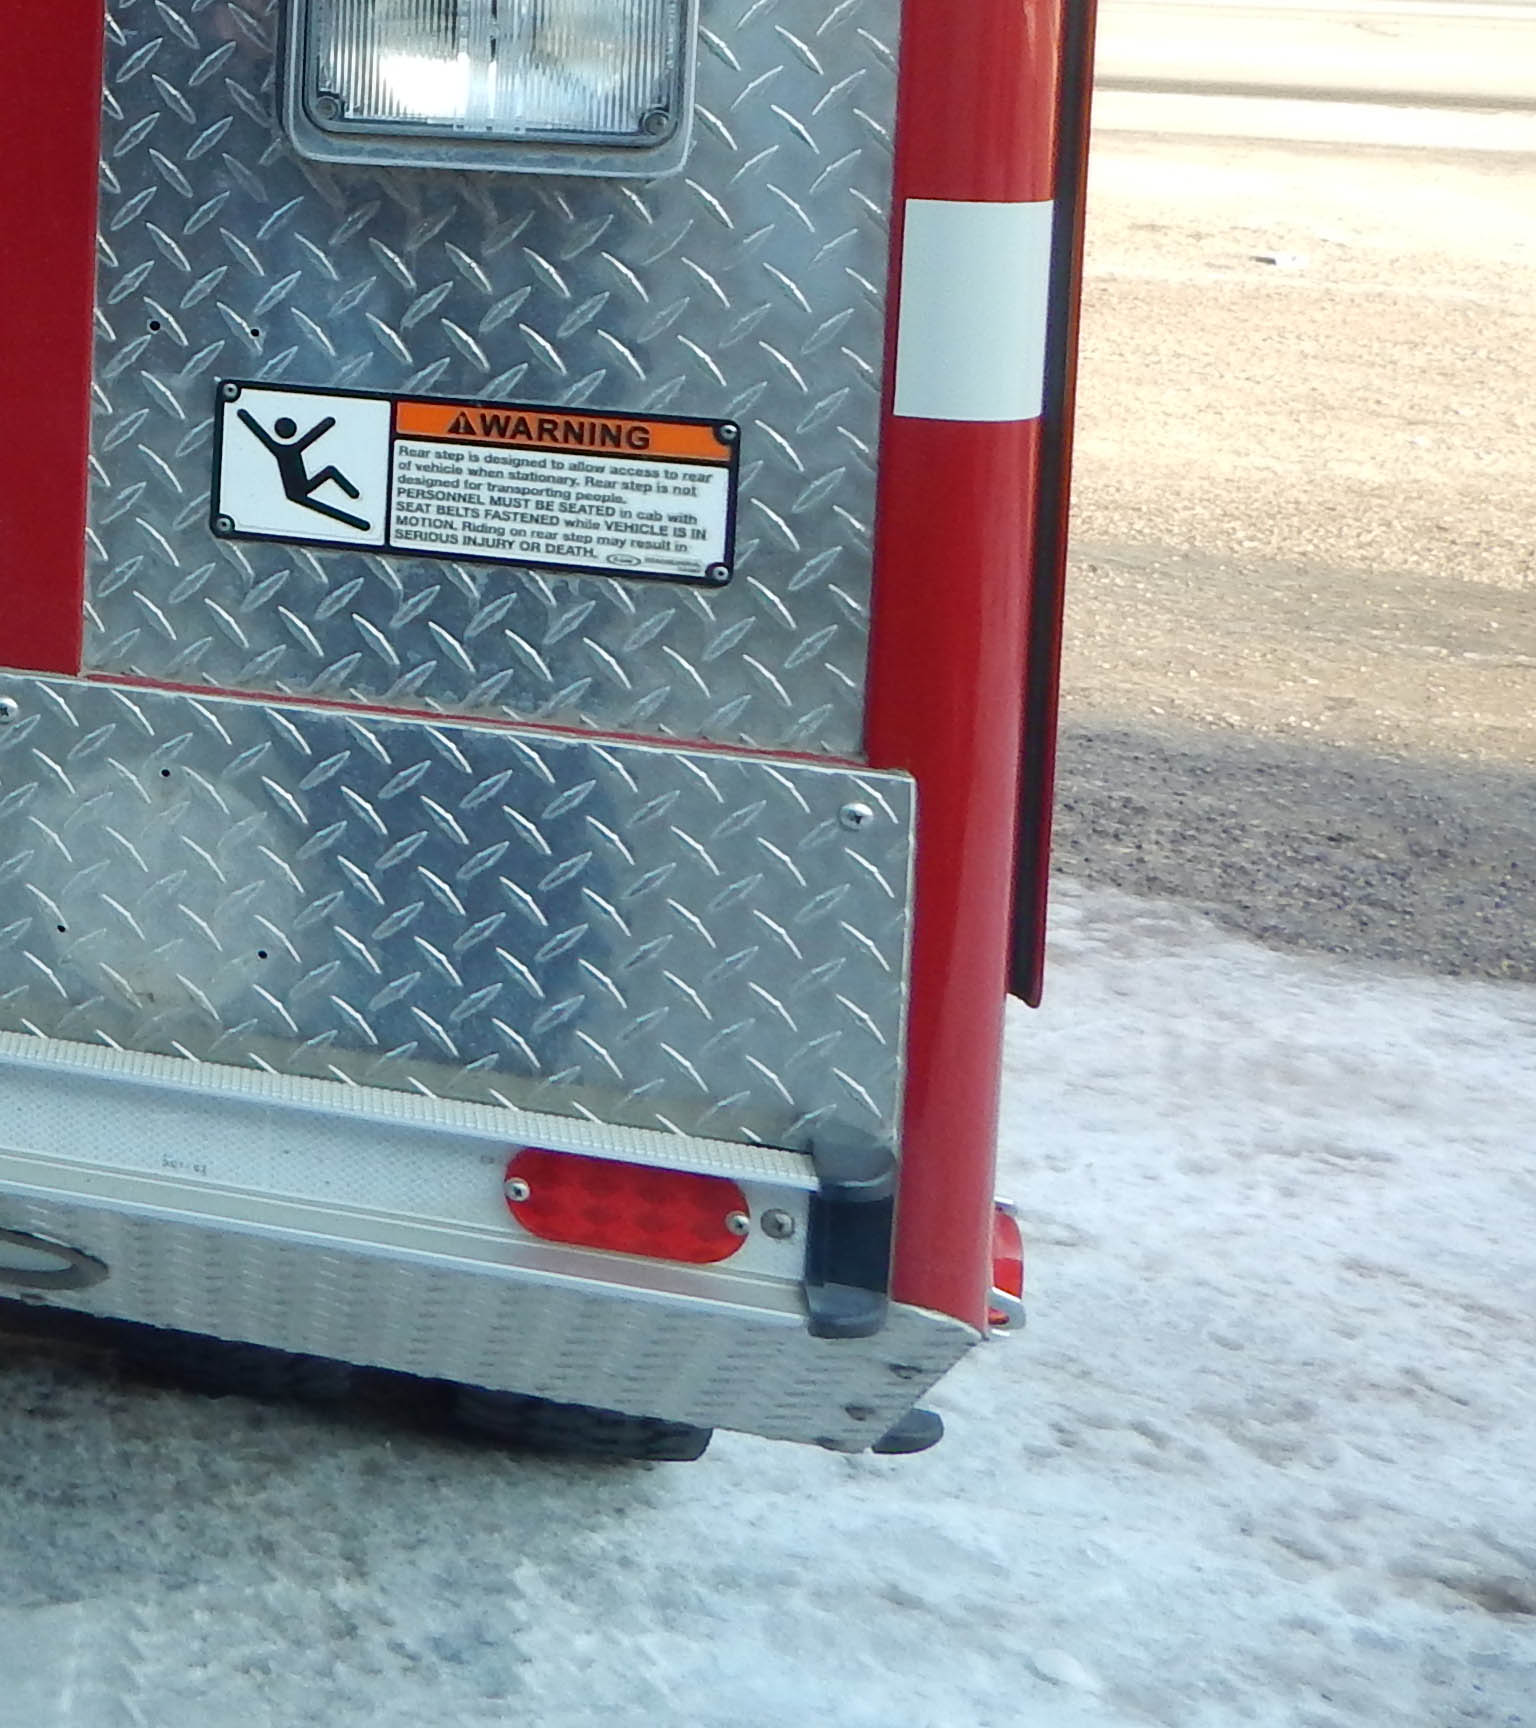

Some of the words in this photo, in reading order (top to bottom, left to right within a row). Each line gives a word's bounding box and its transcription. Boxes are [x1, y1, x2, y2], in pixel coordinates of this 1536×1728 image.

[480, 413, 651, 450] WARNING
[398, 460, 411, 471] of
[415, 462, 463, 475] vehicle
[468, 467, 504, 479] when
[508, 470, 580, 487] stationary.
[585, 476, 618, 489] Rear
[621, 480, 652, 493] step
[657, 482, 669, 493] is
[672, 485, 697, 497] not
[399, 446, 430, 459] Rear
[435, 449, 464, 462] step
[469, 451, 480, 462] is
[484, 453, 547, 468] designed
[551, 459, 565, 470] to
[568, 461, 605, 473] allow
[609, 466, 660, 478] access
[664, 469, 678, 480] to
[682, 472, 712, 483] rear
[397, 474, 460, 488] designed
[464, 478, 484, 490] for
[487, 481, 572, 501] transporting
[576, 491, 627, 505] people.
[397, 487, 485, 505] PERSONNEL
[489, 496, 531, 509] MUST
[535, 500, 555, 511] BE
[558, 501, 616, 517] SEATED
[620, 508, 632, 519] in
[636, 510, 663, 522] cab
[668, 513, 697, 525] with
[395, 515, 457, 531] MOTION.
[462, 521, 506, 536] Riding
[510, 527, 527, 538] on
[530, 528, 559, 540] rear
[563, 532, 593, 545] step
[597, 537, 626, 549] may
[630, 538, 671, 552] result
[675, 541, 688, 552] in
[396, 501, 431, 514] SEAT
[436, 505, 480, 519] BELTS
[484, 509, 560, 526] FASTENED
[565, 518, 600, 530] while
[604, 521, 668, 537] VEHICLE
[673, 527, 687, 539] IS
[691, 529, 708, 541] IN
[394, 528, 459, 545] SERIOUS
[462, 535, 515, 550] INJURY
[519, 540, 541, 552] OR
[545, 542, 598, 559] DEATH.
